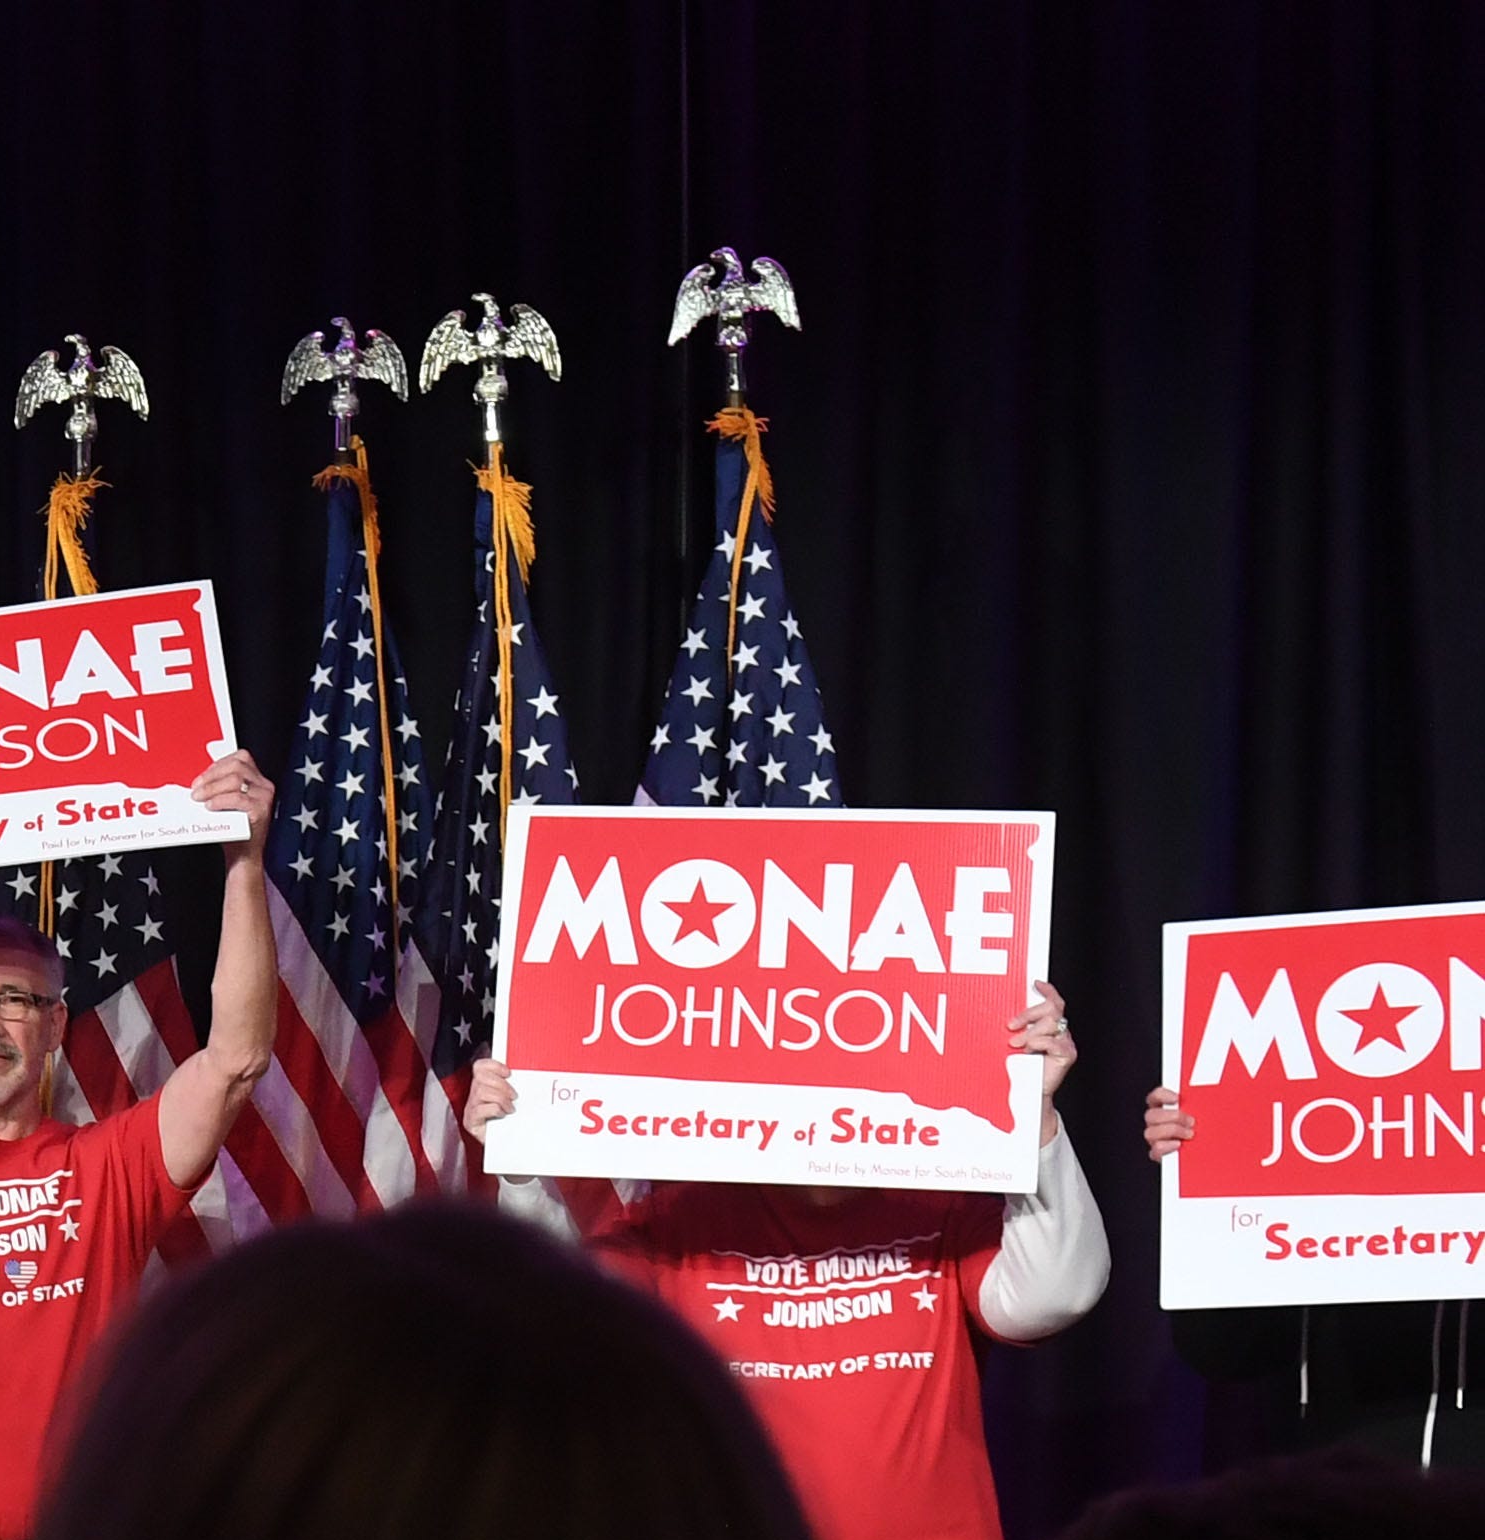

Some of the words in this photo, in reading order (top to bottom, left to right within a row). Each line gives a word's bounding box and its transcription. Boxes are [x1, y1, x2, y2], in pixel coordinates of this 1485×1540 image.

[24, 812, 44, 832] of
[56, 796, 159, 827] State
[41, 838, 63, 850] Paid
[66, 837, 80, 848] for
[84, 836, 96, 846] by
[140, 829, 155, 840] for
[158, 827, 189, 838] South
[191, 823, 231, 834] Dakota
[521, 854, 1014, 976] MONAE
[581, 982, 948, 1056] JOHNSON
[550, 1079, 580, 1104] for
[580, 1098, 779, 1151] Secretary
[793, 1122, 816, 1145] of
[830, 1107, 941, 1147] State
[1261, 1091, 1485, 1167] JOHN
[808, 1161, 831, 1173] Paid
[834, 1162, 850, 1175] for
[854, 1163, 867, 1176] by
[915, 1165, 930, 1178] for
[934, 1166, 967, 1179] South
[971, 1167, 1013, 1181] Dakota
[1231, 1205, 1262, 1231] for
[1265, 1222, 1485, 1264] Secretary
[746, 1258, 808, 1286] VOTE
[815, 1246, 912, 1284] MONAE
[2, 1290, 28, 1307] OF
[763, 1289, 892, 1329] JOHNSON
[731, 1360, 836, 1380] ECRETARY
[840, 1358, 869, 1374] OF
[874, 1352, 934, 1371] STATE
